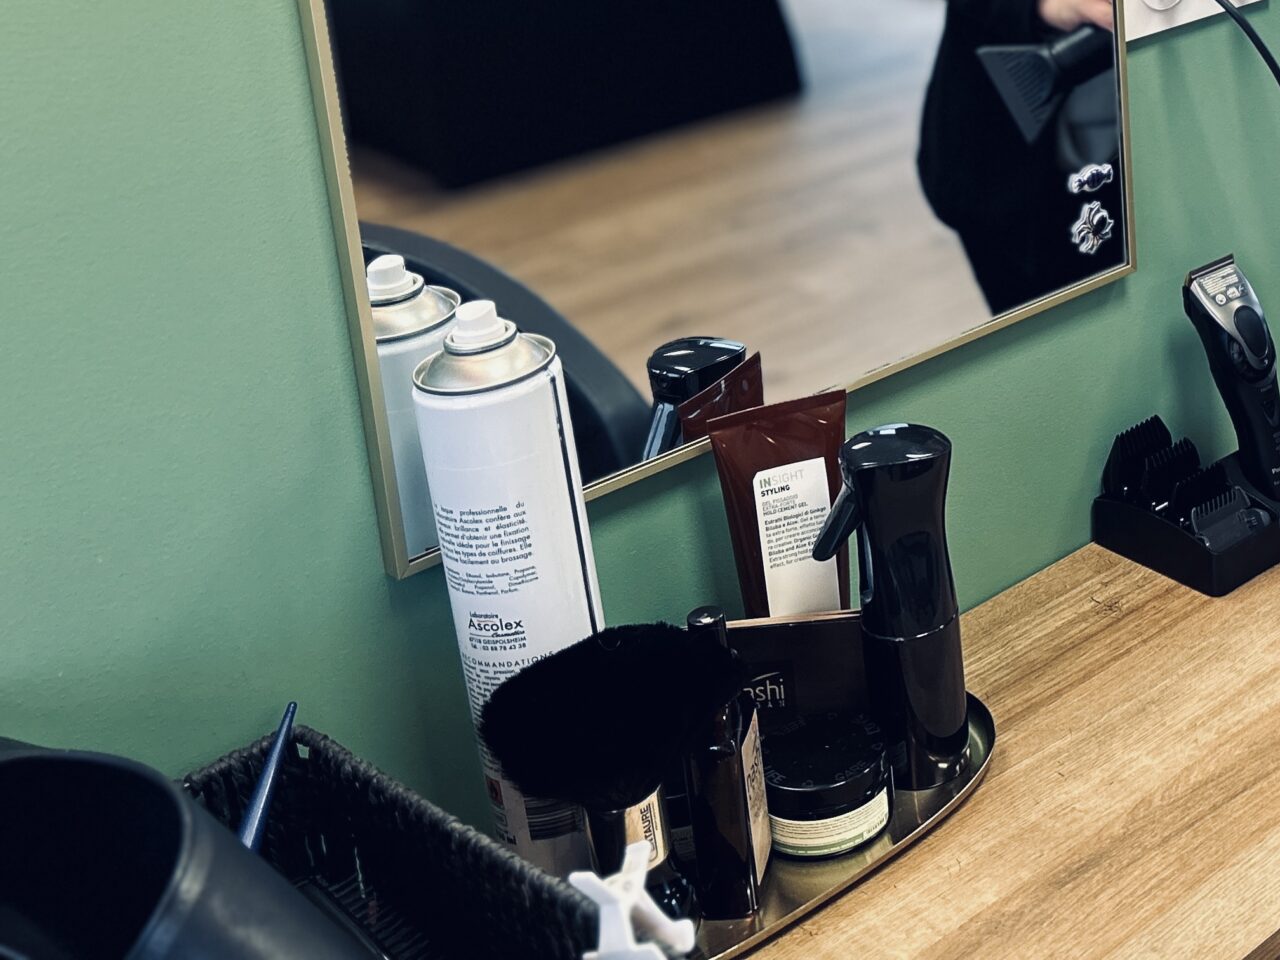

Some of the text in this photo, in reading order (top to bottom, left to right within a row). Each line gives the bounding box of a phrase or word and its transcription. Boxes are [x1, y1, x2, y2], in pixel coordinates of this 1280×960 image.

[759, 469, 805, 489] INSIGHT
[761, 484, 791, 497] STYLING
[459, 505, 508, 517] professionnelle
[515, 501, 525, 509] du
[485, 513, 511, 523] confère
[513, 510, 526, 518] aux
[454, 523, 480, 533] brillance
[460, 532, 488, 541] d'obtenir
[503, 526, 529, 538] fixation
[500, 534, 531, 546] finissage
[462, 550, 477, 558] types
[519, 542, 533, 551] Elle
[469, 611, 499, 619] Laboratoire
[468, 618, 524, 632] Ascolex
[482, 636, 527, 645] GEISPOLSHEIM
[640, 803, 655, 846] TAURE
